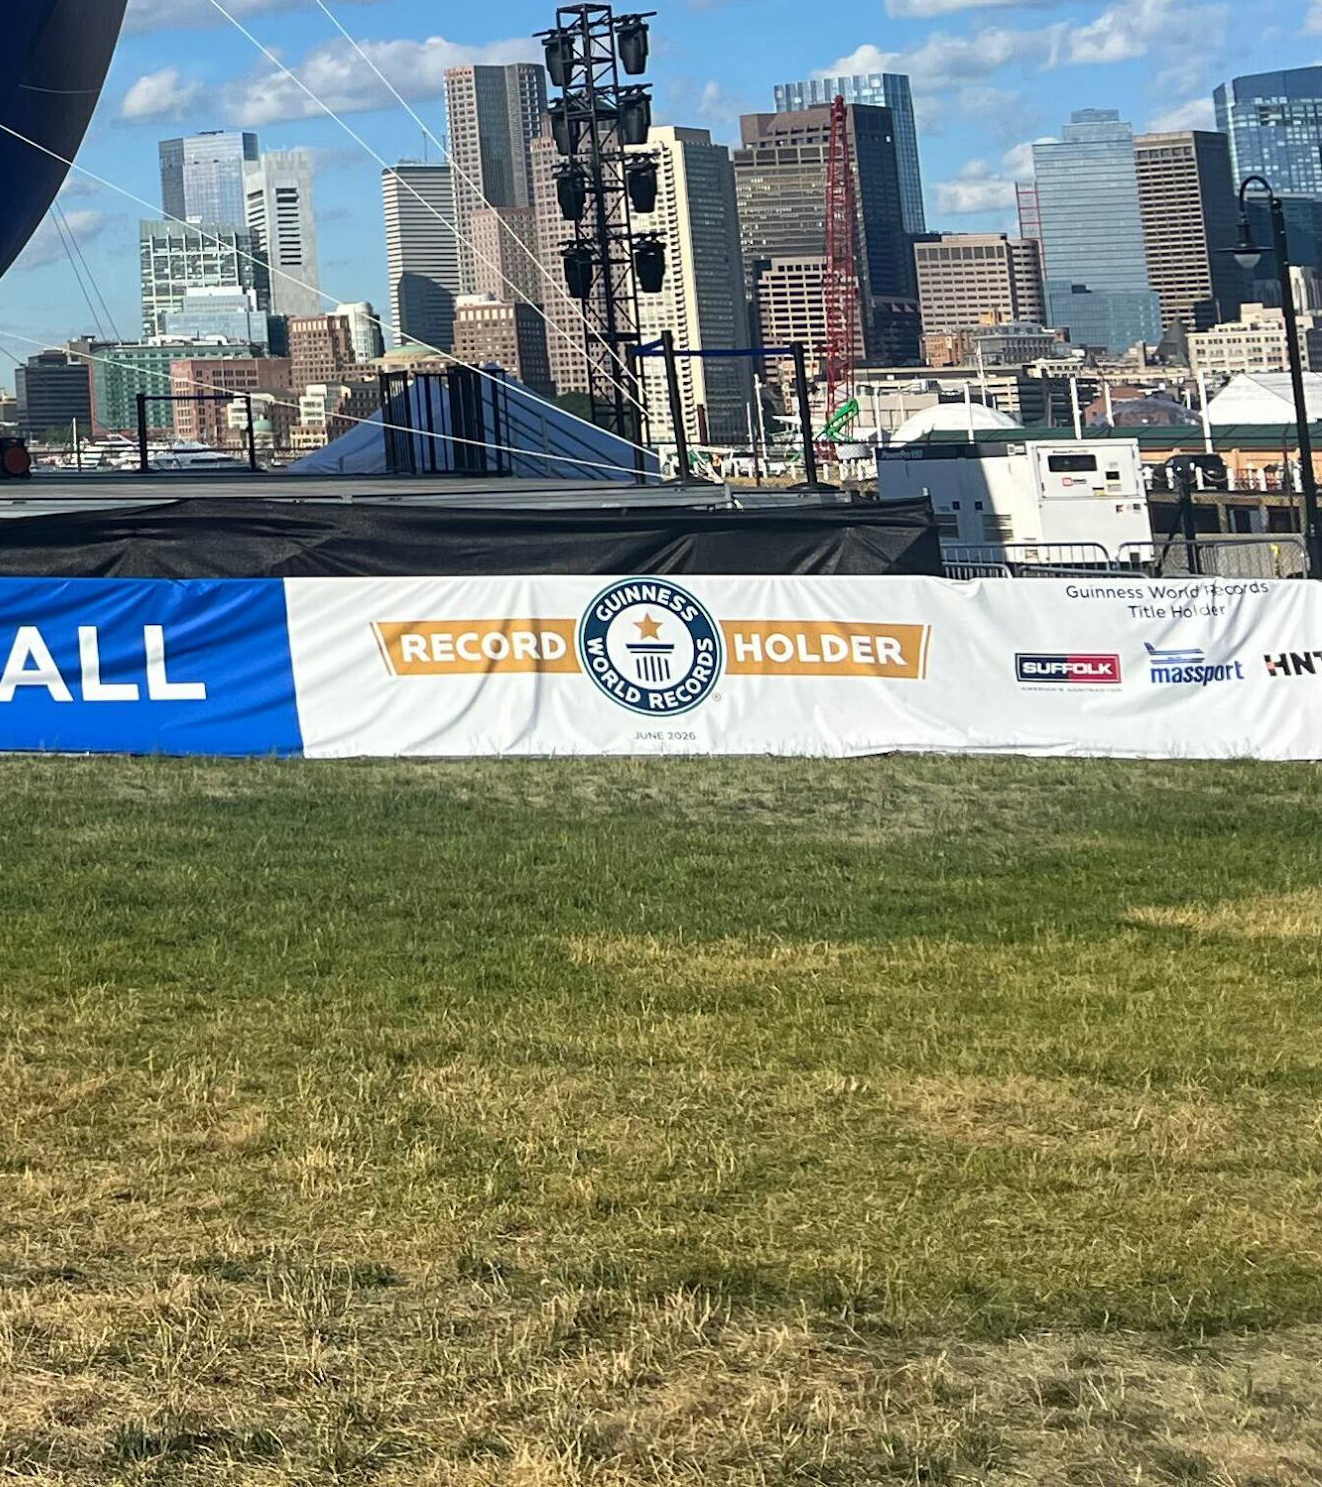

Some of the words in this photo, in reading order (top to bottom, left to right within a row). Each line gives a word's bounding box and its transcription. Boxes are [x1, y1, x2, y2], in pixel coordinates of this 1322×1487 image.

[595, 584, 699, 623] GUINNESS
[1065, 584, 1145, 600] Guinness
[1147, 581, 1199, 600] World
[1127, 604, 1166, 619] Title
[1170, 603, 1226, 618] Holder
[400, 631, 567, 663] RECORD
[734, 633, 906, 666] HOLDER
[586, 636, 641, 703] WORLD
[648, 636, 714, 709] RECORDS
[1021, 660, 1114, 676] SUFFOLK
[1150, 660, 1245, 687] massport
[634, 730, 664, 741] JUNE
[667, 730, 697, 742] 2026
